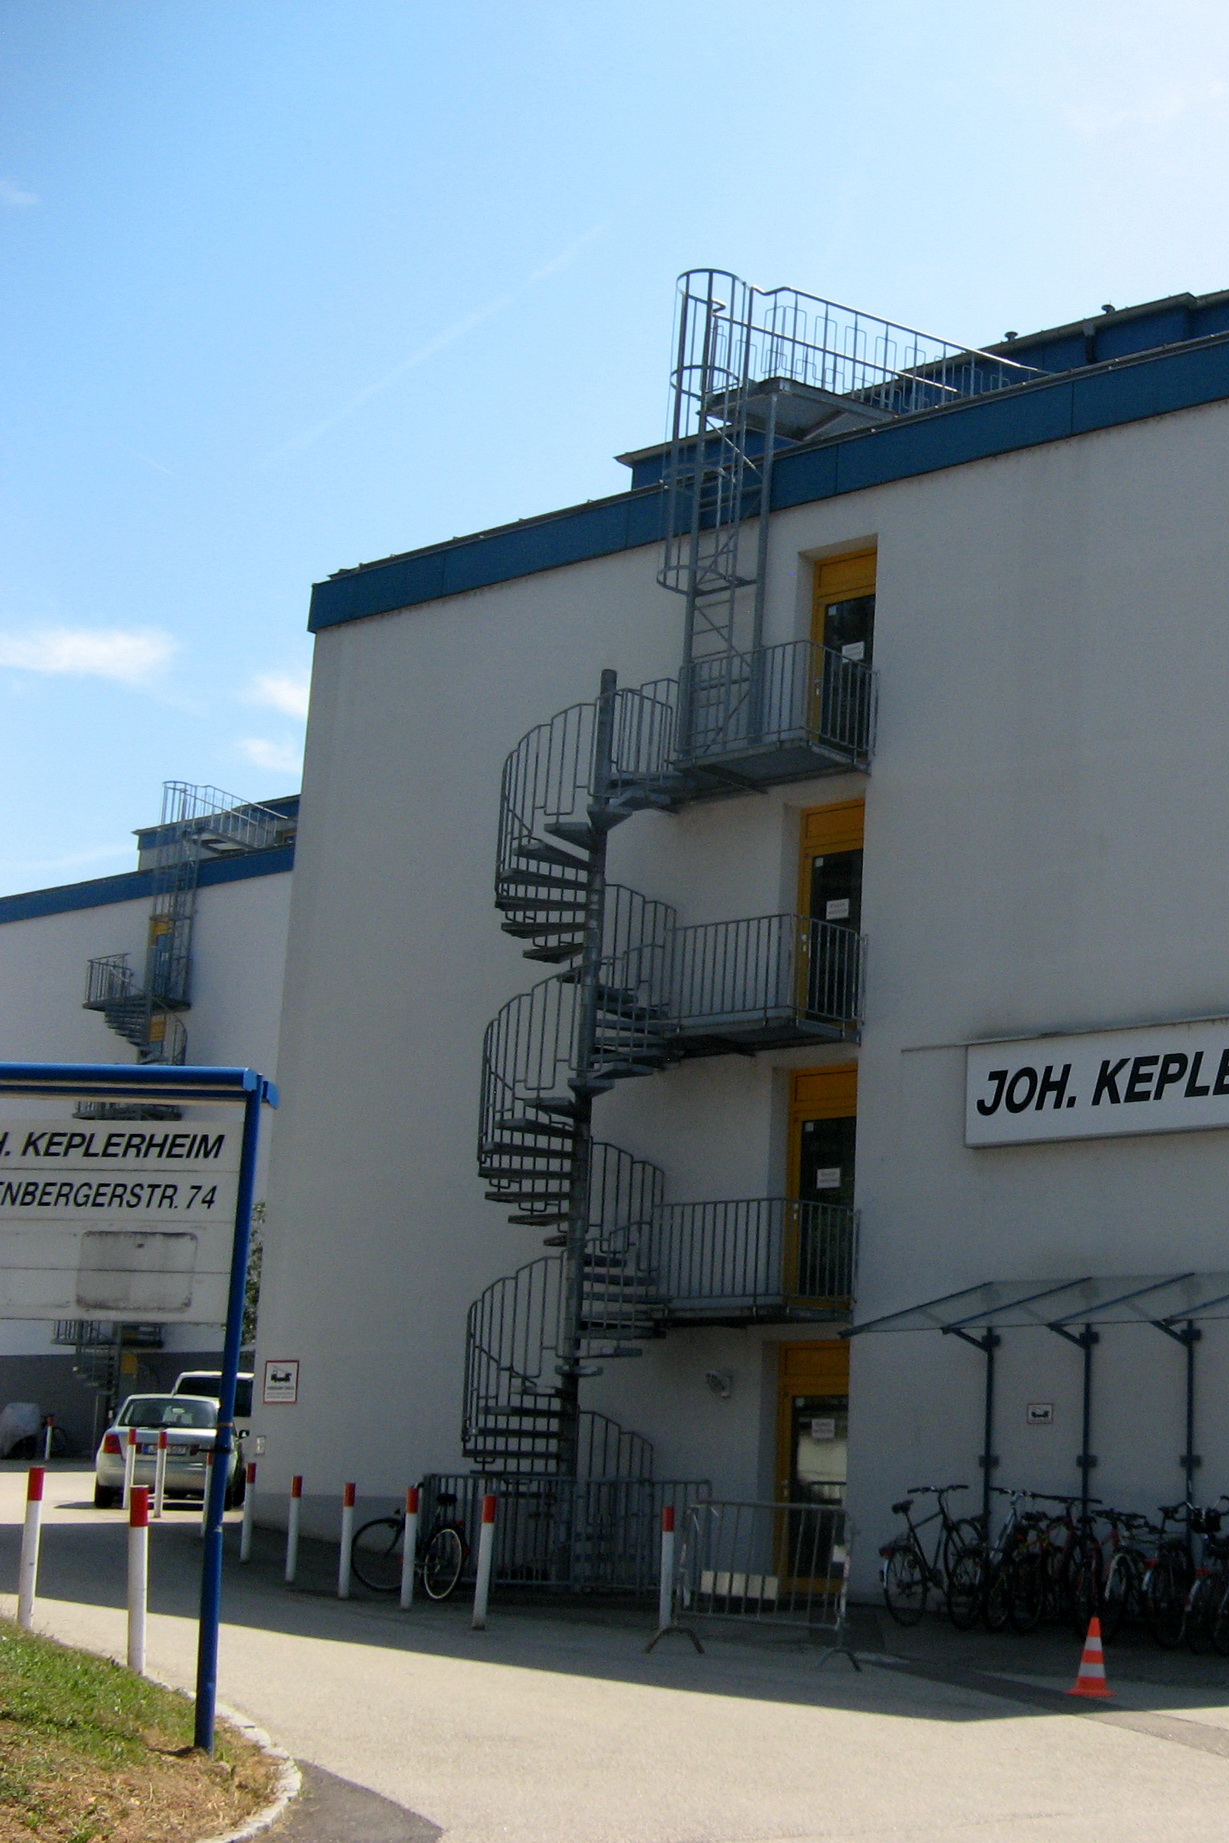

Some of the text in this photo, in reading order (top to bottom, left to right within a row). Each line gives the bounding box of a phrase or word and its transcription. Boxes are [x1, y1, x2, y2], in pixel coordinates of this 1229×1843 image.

[976, 1063, 1077, 1116] JOH.
[21, 1131, 225, 1159] KEPLERHEIM
[0, 1181, 217, 1209] NBERGERSTR. 74
